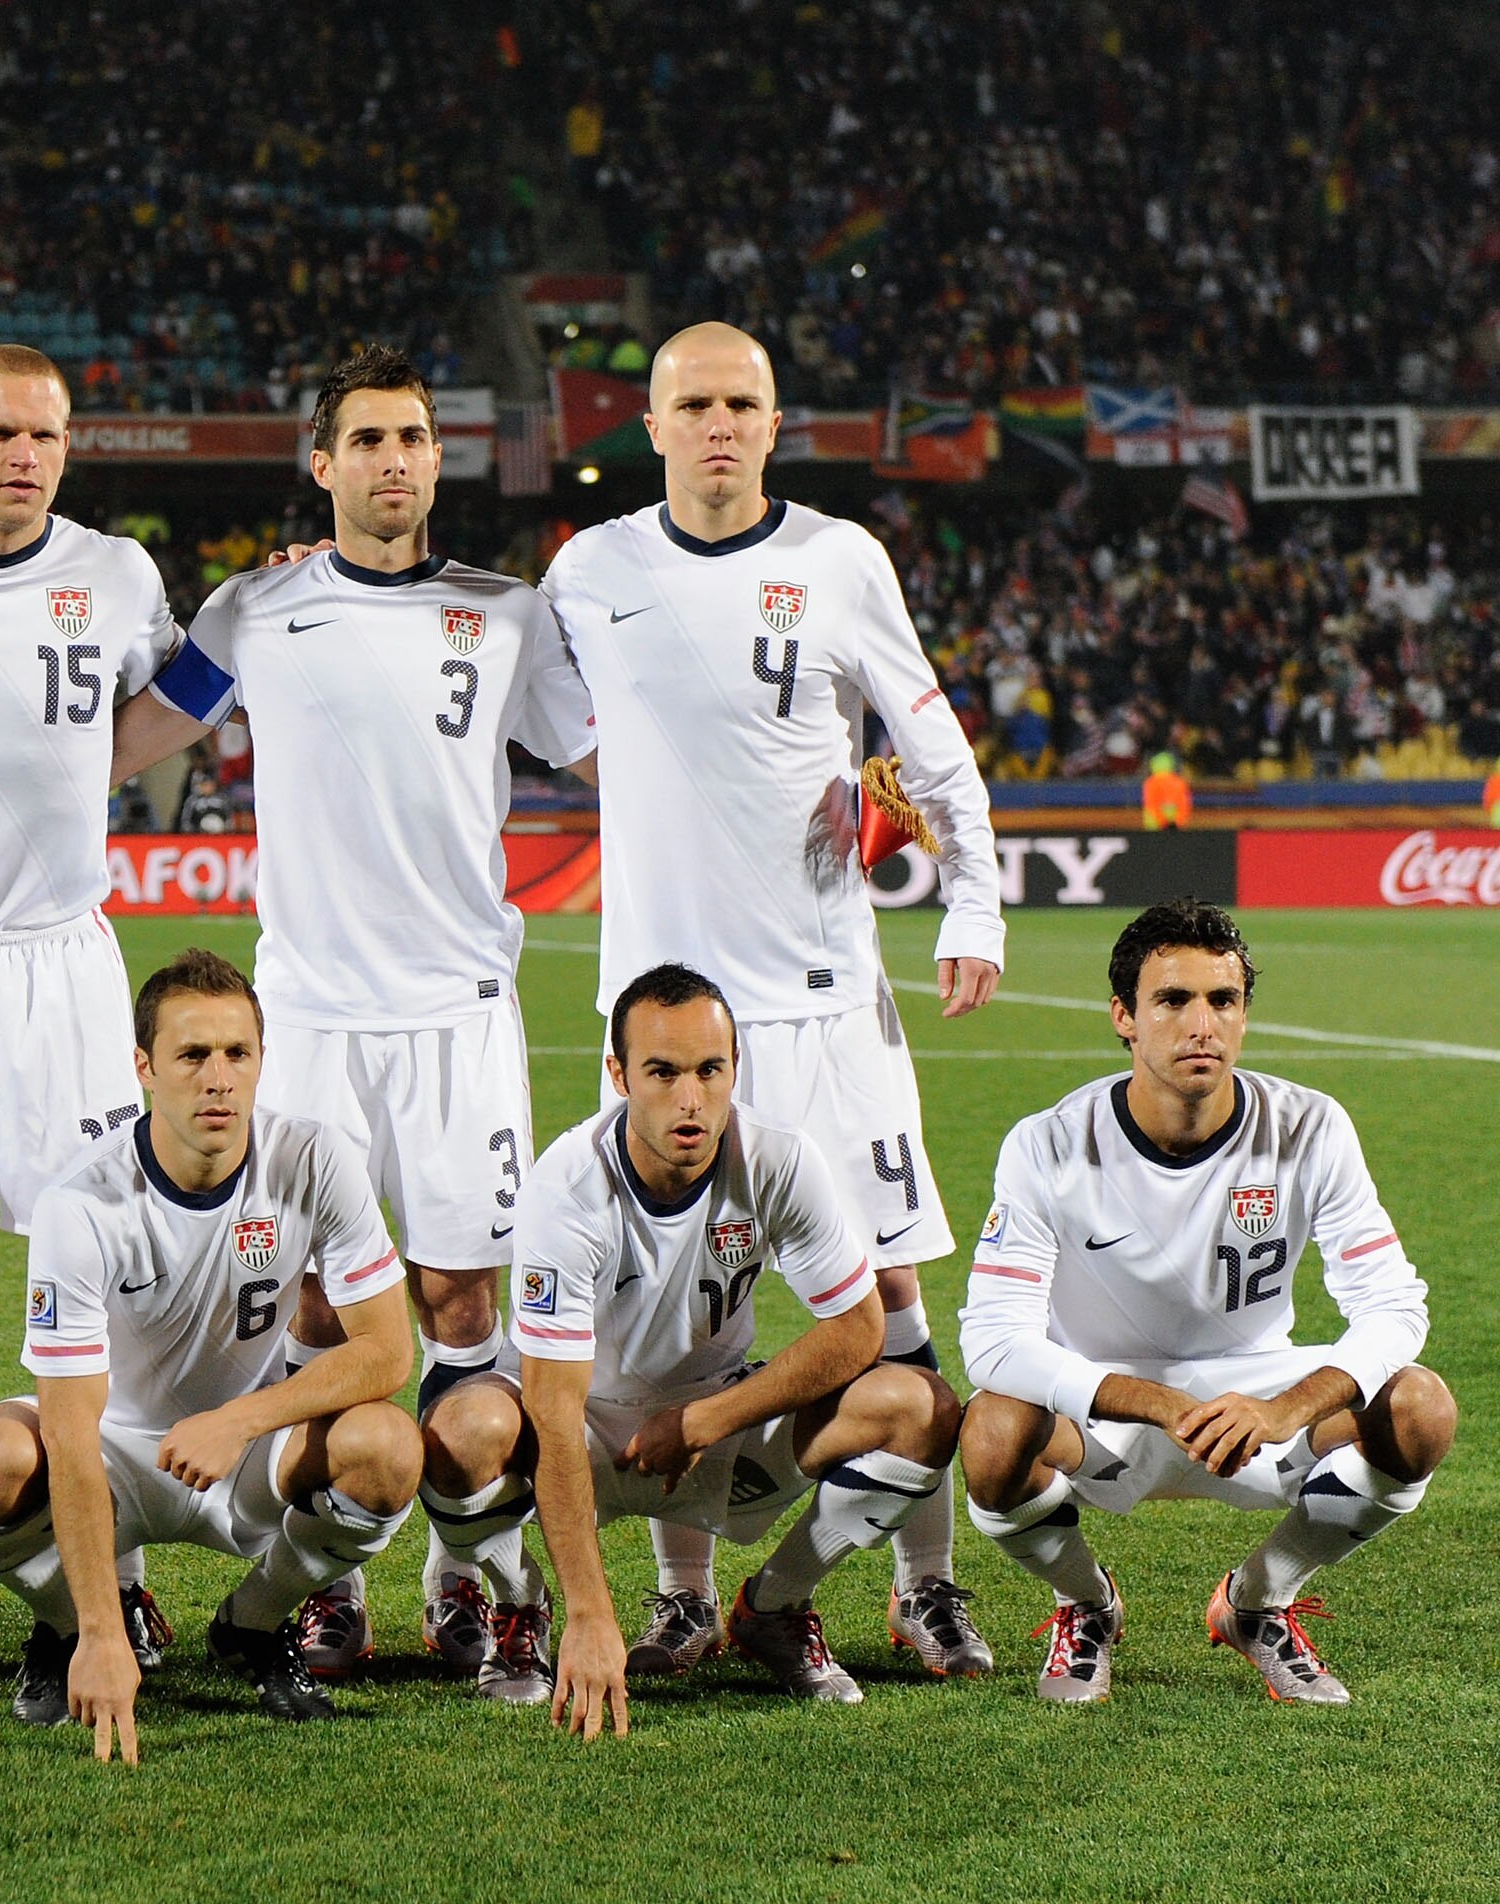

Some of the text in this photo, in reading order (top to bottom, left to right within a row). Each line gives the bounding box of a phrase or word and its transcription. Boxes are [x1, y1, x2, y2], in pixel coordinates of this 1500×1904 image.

[37, 645, 101, 725] 15
[435, 659, 479, 739] 3
[753, 636, 799, 718] 4
[108, 846, 258, 904] AFOK
[489, 1127, 522, 1209] 3
[871, 1132, 919, 1211] 4
[236, 1279, 280, 1340] 6
[1217, 1237, 1287, 1313] 12
